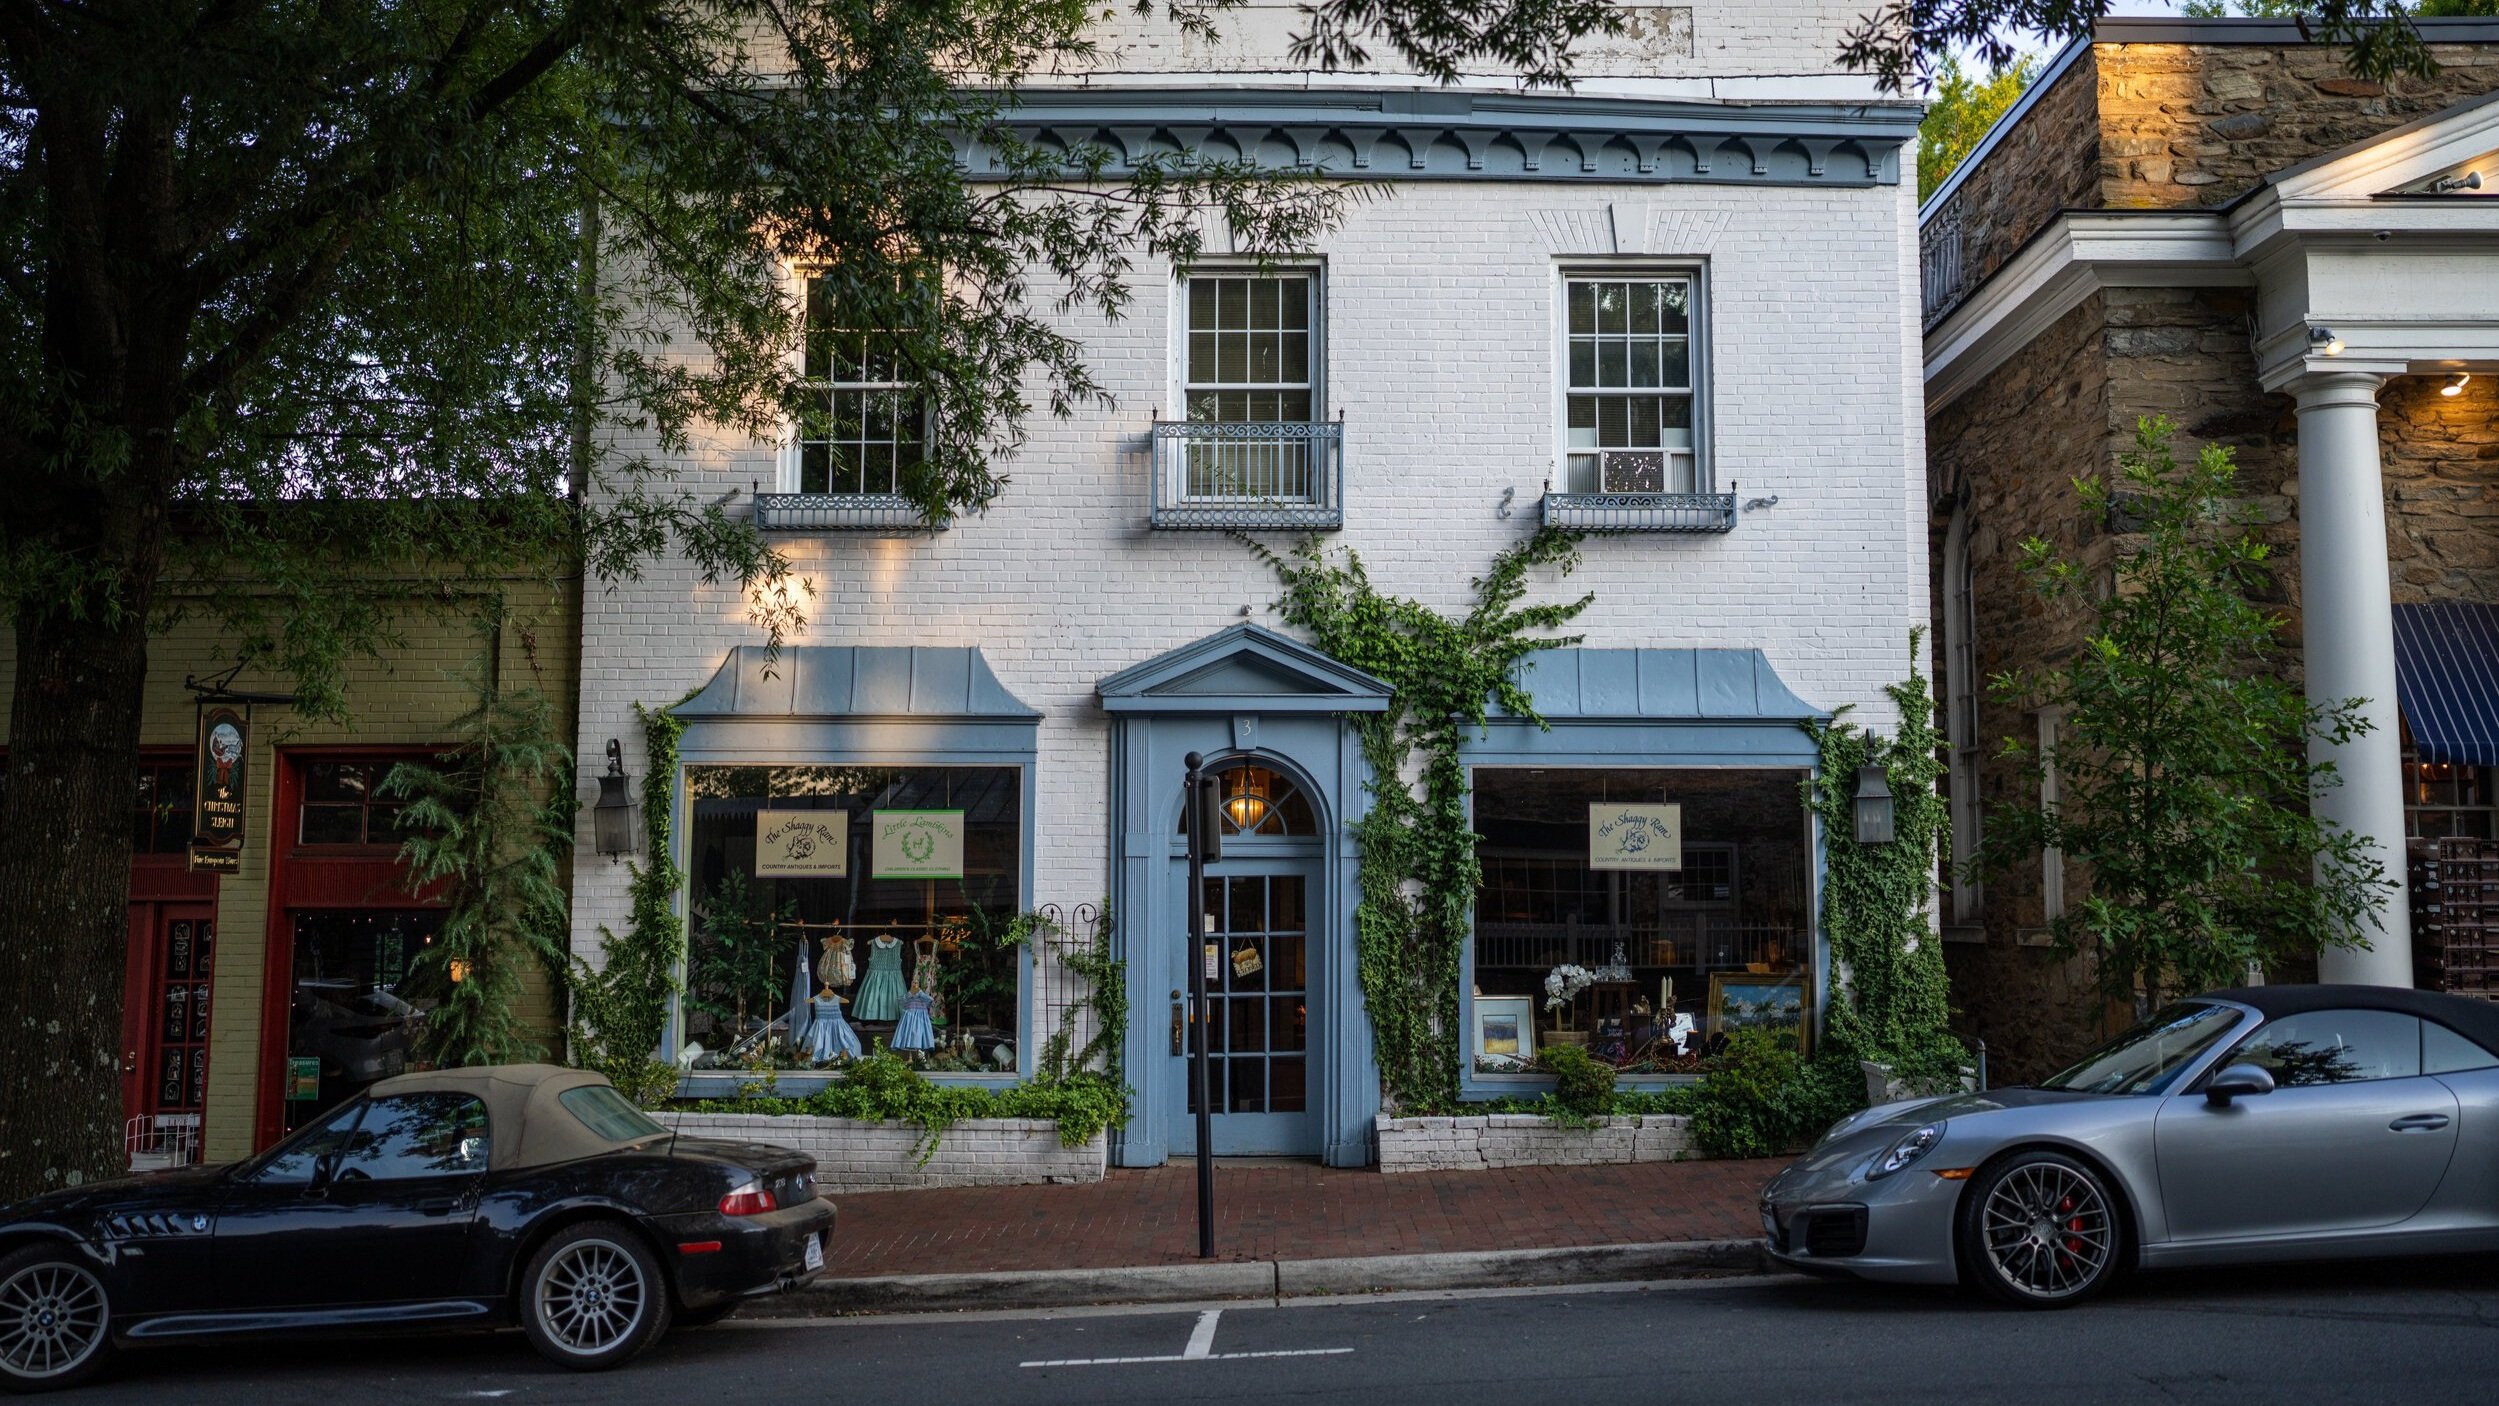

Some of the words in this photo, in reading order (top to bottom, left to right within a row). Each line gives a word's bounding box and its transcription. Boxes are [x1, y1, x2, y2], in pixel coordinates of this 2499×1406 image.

[1240, 719, 1251, 736] 3
[204, 800, 241, 813] CHRISTMAS
[211, 816, 234, 829] SLEIGH
[765, 827, 781, 845] The
[781, 816, 815, 837] Shaggy
[816, 824, 838, 846] Ram
[882, 819, 908, 840] Little
[910, 816, 954, 839] Lambkins
[1598, 820, 1614, 838] The
[1614, 809, 1648, 830] Shaggy
[1650, 817, 1671, 839] Ram
